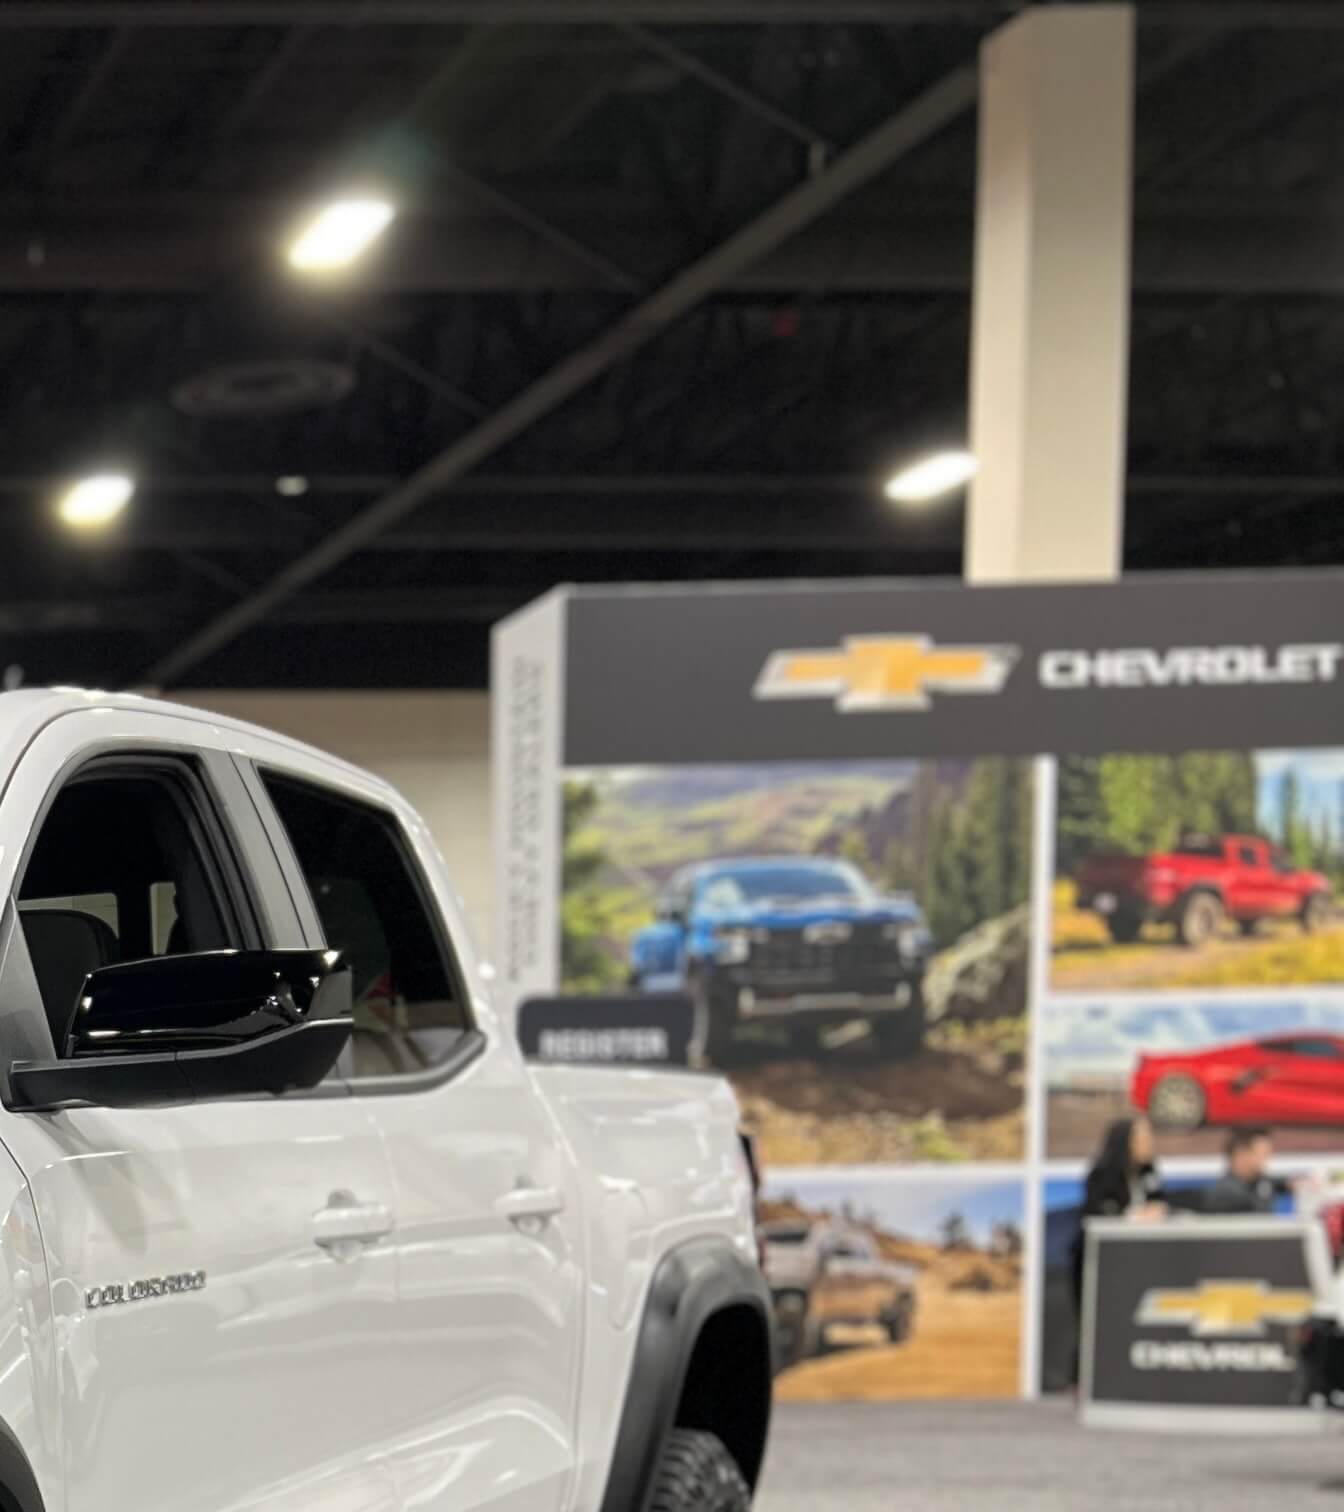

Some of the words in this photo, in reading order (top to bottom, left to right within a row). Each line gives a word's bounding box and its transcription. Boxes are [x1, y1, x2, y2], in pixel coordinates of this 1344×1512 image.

[1037, 643, 1344, 688] CHEVROLET
[539, 1027, 669, 1060] REGISTER
[85, 1270, 207, 1309] COLORADO
[1129, 1340, 1298, 1372] CHEVROL
